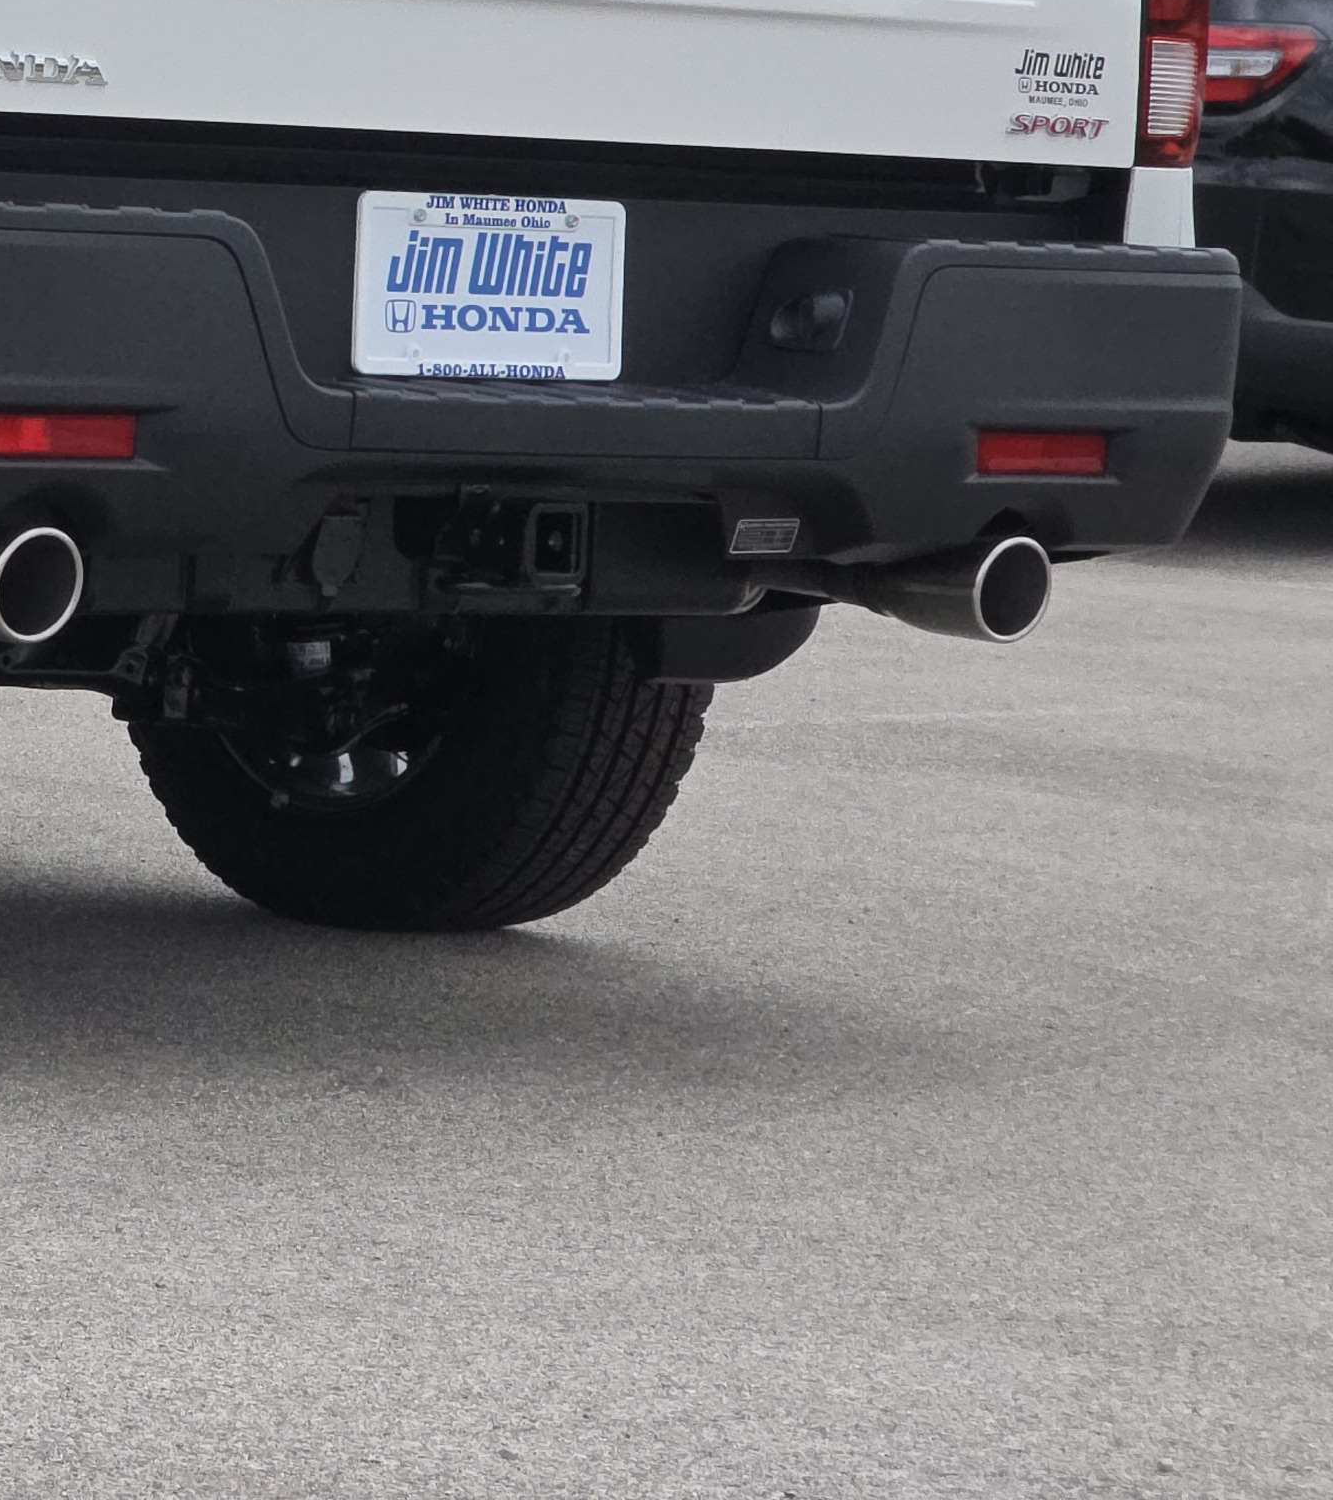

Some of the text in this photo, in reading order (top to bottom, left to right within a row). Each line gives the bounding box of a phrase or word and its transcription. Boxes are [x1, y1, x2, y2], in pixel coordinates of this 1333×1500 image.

[1034, 80, 1099, 95] HONDA
[1006, 111, 1110, 140] SPORT
[426, 194, 567, 214] JIM WHITE HONDA
[445, 212, 551, 229] In Maumee Ohio
[421, 304, 590, 334] HONDA
[418, 363, 566, 379] 1-800-ALL-HONDA
